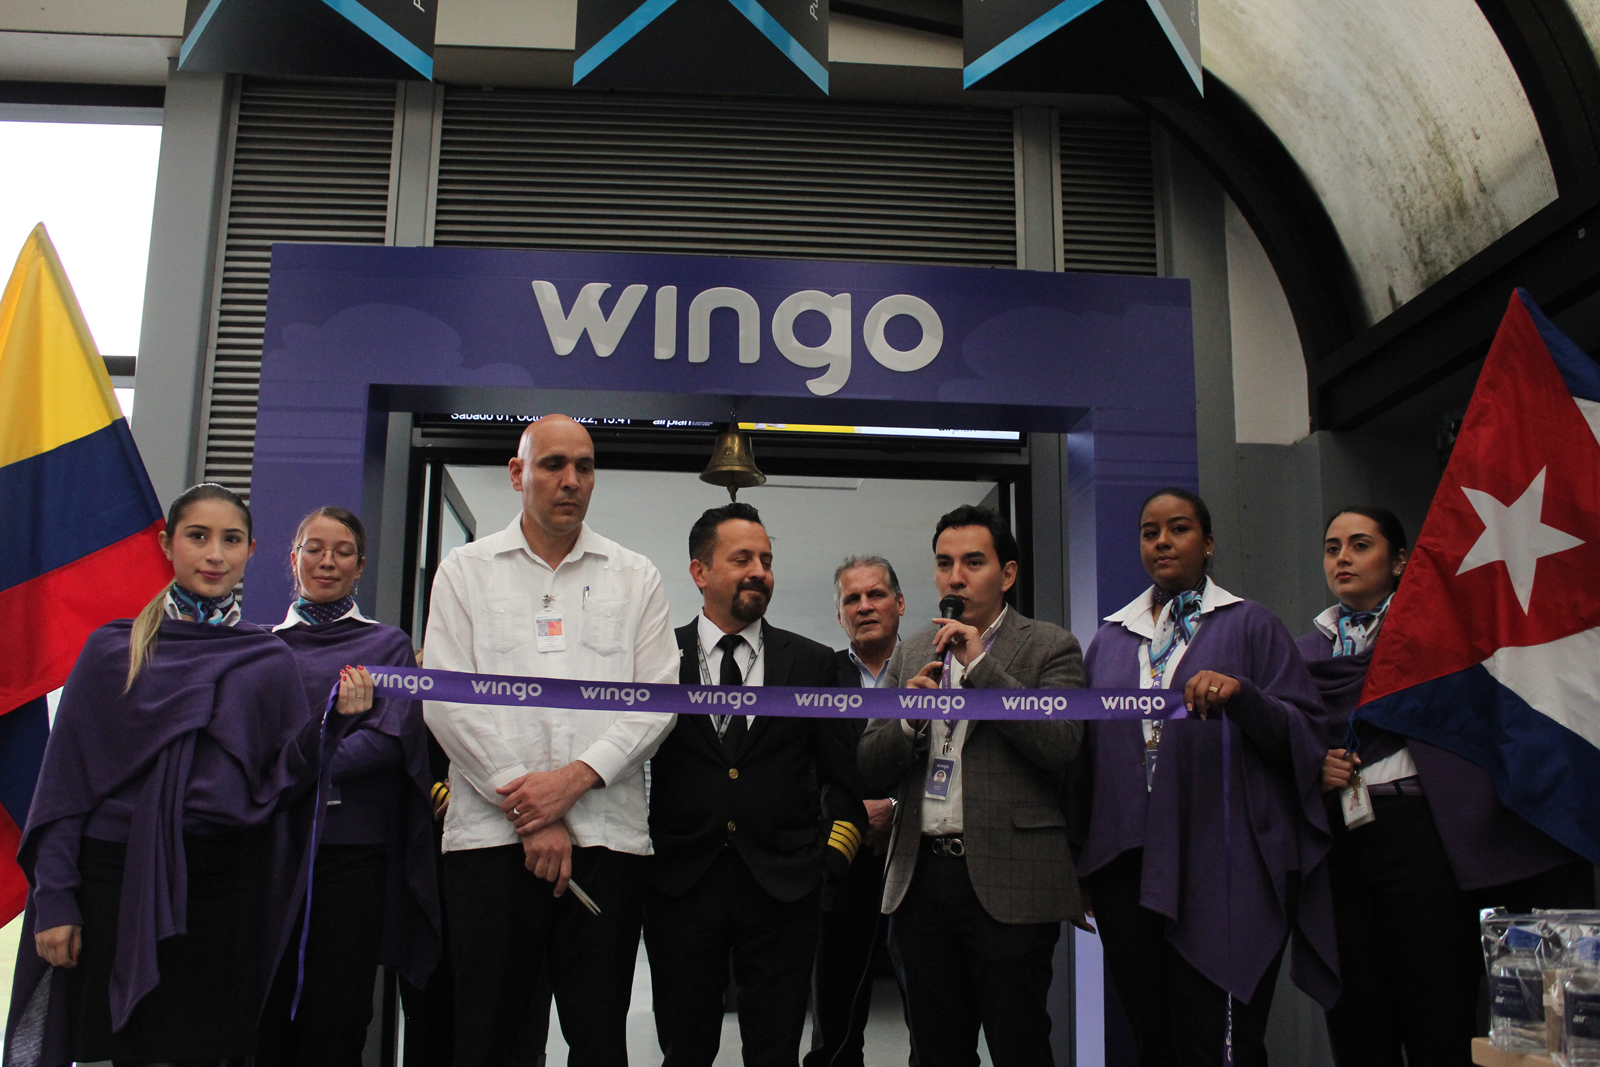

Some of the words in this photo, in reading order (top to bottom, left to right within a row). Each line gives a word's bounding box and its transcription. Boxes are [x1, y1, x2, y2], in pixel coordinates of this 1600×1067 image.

[531, 280, 944, 396] wingo
[471, 680, 542, 701] wingo
[580, 685, 651, 706] wingo
[687, 690, 757, 710] wingo
[795, 692, 863, 713] wingo
[899, 694, 965, 714] wingo
[1002, 695, 1067, 715] wingo
[1101, 695, 1166, 715] wingo
